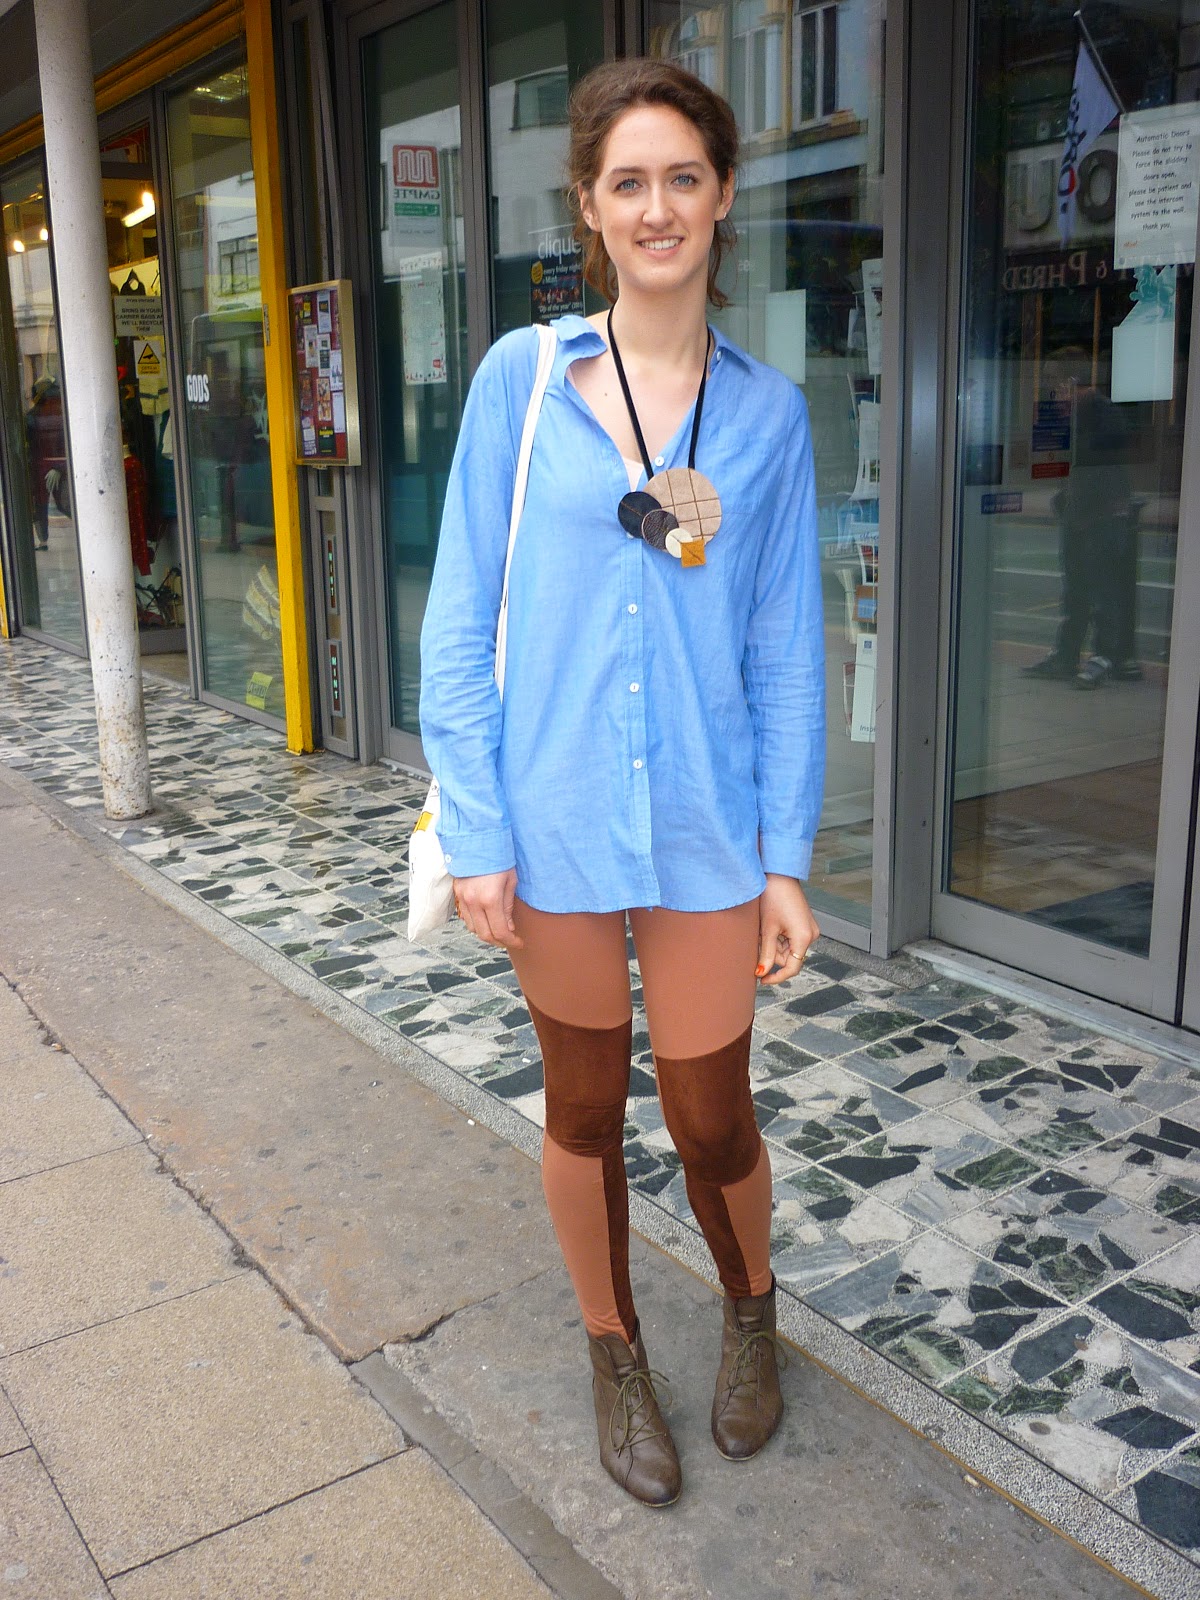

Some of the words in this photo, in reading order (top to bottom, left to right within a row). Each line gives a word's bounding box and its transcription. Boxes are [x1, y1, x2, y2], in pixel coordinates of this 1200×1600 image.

[1136, 132, 1169, 143] Automatic
[1171, 129, 1190, 138] Doors
[1132, 149, 1150, 157] Please
[1152, 147, 1160, 155] do
[1174, 144, 1184, 152] try
[1135, 161, 1151, 169] force
[1128, 188, 1147, 198] please
[1148, 186, 1156, 194] be
[1157, 184, 1179, 194] patient
[1180, 182, 1192, 190] and
[1158, 196, 1184, 204] intercom
[1130, 210, 1151, 220] system
[1142, 222, 1158, 231] thank
[537, 232, 582, 265] clique
